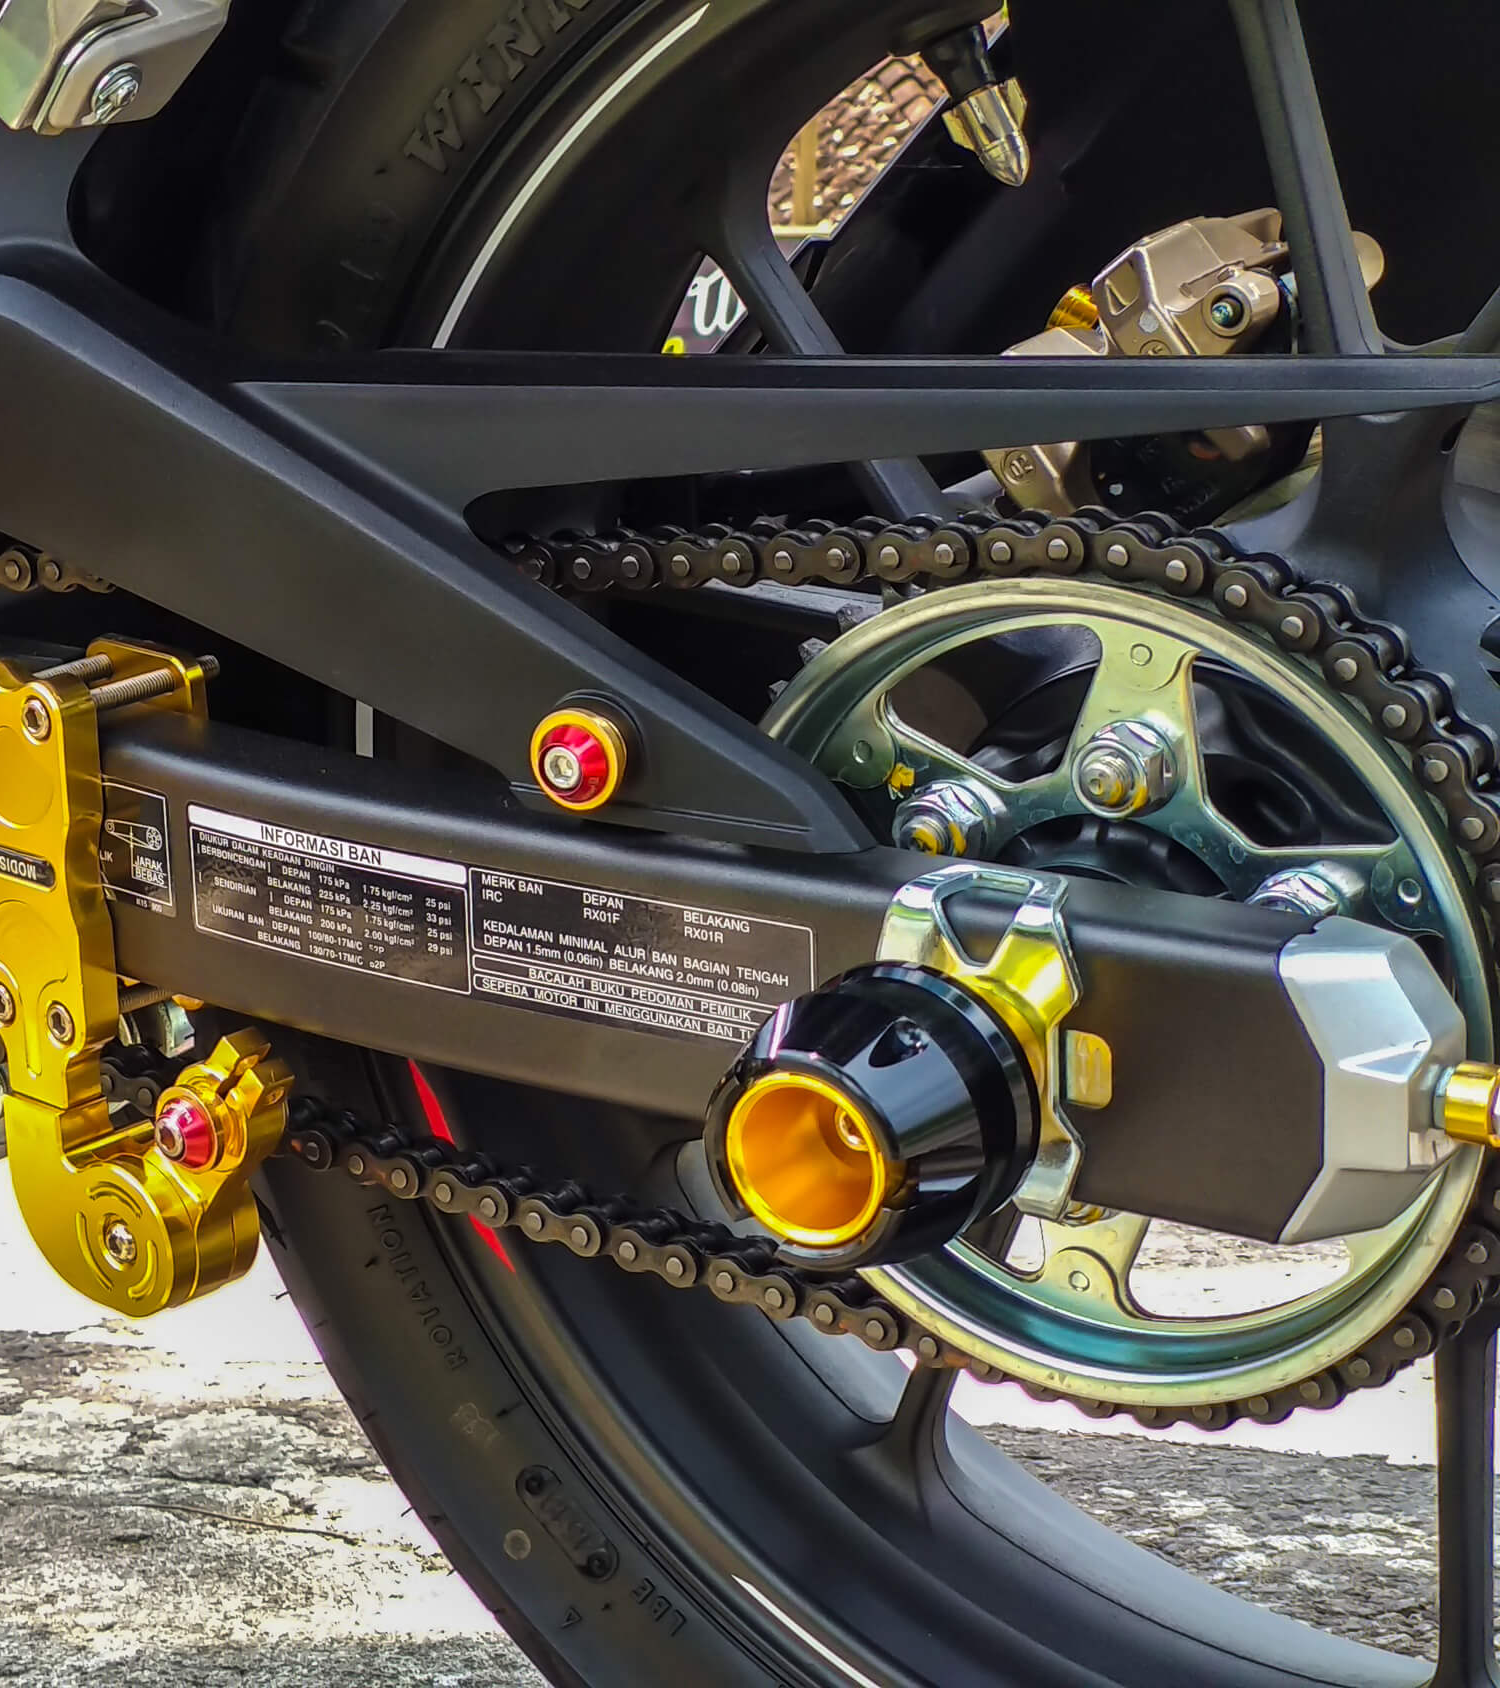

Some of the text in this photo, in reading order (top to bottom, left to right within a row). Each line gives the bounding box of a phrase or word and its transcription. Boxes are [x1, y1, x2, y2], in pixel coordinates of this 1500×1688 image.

[135, 855, 163, 872] JARAK
[199, 831, 335, 874] DIUKUR DALAM KEADAAN DINGIN
[260, 824, 382, 866] INFORMASI BAN
[135, 867, 165, 885] BEBAS
[282, 864, 311, 881] DEPAN
[318, 875, 333, 887] 175
[334, 877, 350, 890] kPa
[362, 884, 380, 896] 1.75
[425, 897, 437, 908] 25
[438, 901, 451, 911] psi
[481, 873, 543, 896] MERK BAN
[214, 876, 257, 896] SENDIRIAN
[283, 894, 312, 910] DEPAN
[320, 904, 335, 916] 175
[336, 906, 352, 920] kPa
[364, 914, 382, 926] 1.75
[427, 927, 438, 938] 25
[440, 931, 453, 942] psi
[267, 876, 311, 895] BELAKANG
[318, 889, 334, 900] 225
[335, 891, 351, 905] kPa
[362, 899, 381, 911] 2.25
[426, 912, 437, 923] 33
[438, 915, 452, 926] psi
[482, 888, 724, 944] IRC RX01F RX01R
[582, 892, 750, 933] DEPAN BELAKANG
[212, 903, 245, 921] UKURAN
[247, 914, 265, 927] BAN
[271, 920, 301, 936] DEPAN
[307, 930, 363, 951] 100/80-17M/C
[257, 930, 301, 950] BELAKANG
[308, 944, 364, 966] 130/70-17M/C
[268, 905, 313, 925] BELAKANG
[320, 918, 336, 930] 200
[336, 921, 353, 935] kPa
[364, 928, 383, 941] 2.00
[427, 942, 439, 953] 29
[440, 945, 453, 956] psi
[483, 919, 789, 987] KEDALAMAN MINIMAL ALUR BAN BAGIAN TENGAH
[484, 933, 760, 999] DEPAN 1.5mm (0.06in) BELAKANG 2.0mm (0.08in)
[482, 976, 529, 997] SEPEDA
[534, 988, 578, 1007] MOTOR
[583, 998, 600, 1012] INI
[605, 1002, 701, 1031] MENGGUNAKAN
[707, 1021, 733, 1038] BAN
[528, 967, 751, 1021] BACALAH BUKU PEDOMAN PEMILIK
[366, 1203, 469, 1371] ROTATION
